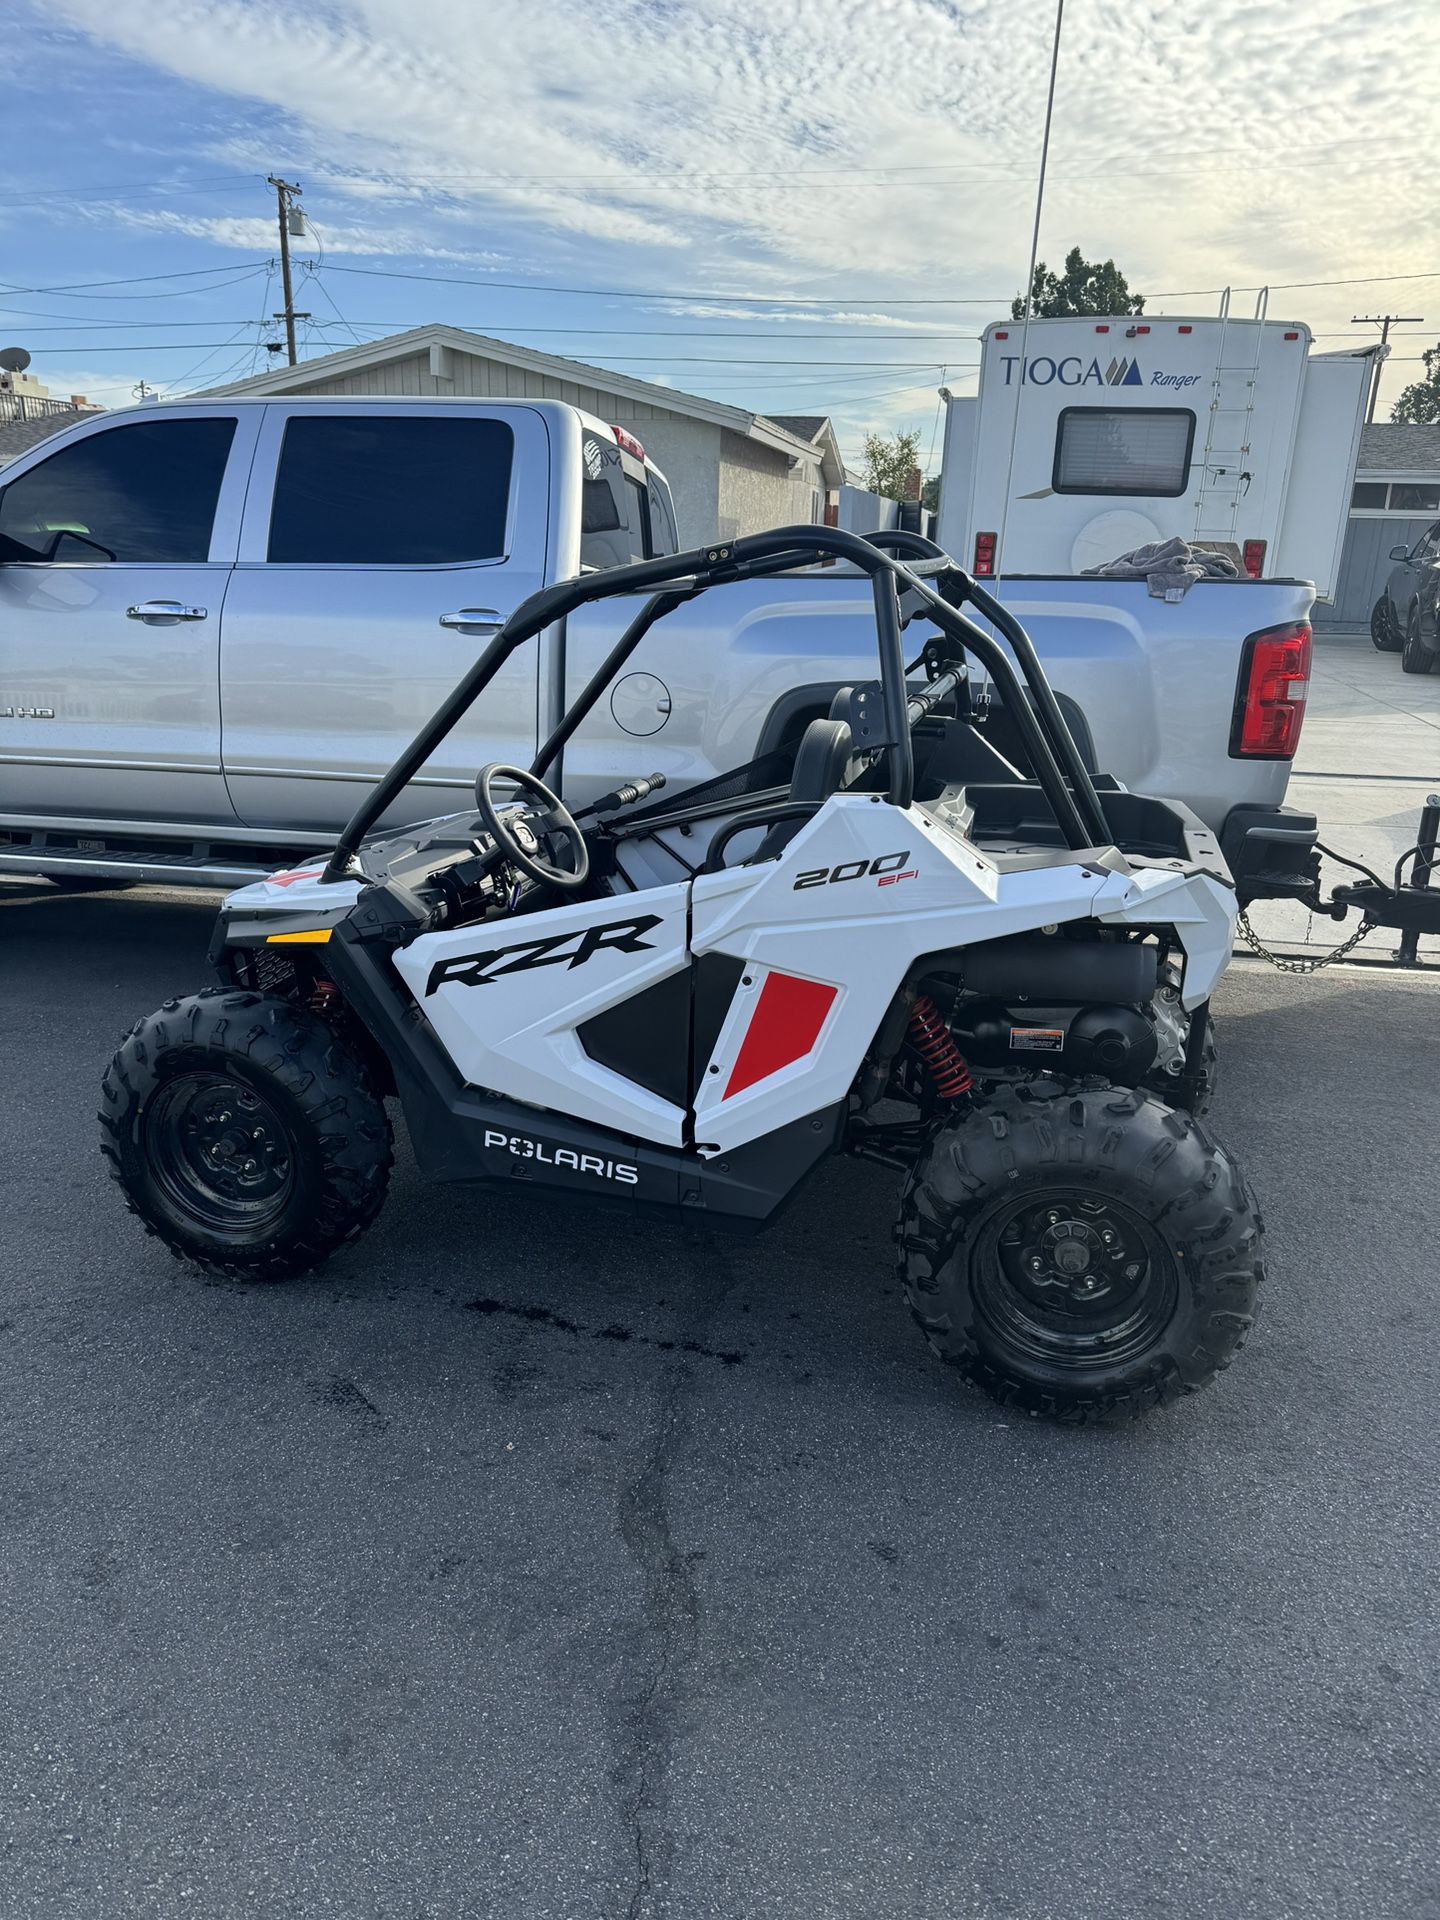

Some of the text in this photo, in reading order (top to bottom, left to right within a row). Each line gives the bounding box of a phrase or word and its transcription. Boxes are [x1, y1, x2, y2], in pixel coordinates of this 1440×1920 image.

[1000, 356, 1202, 391] TIOGA Ranger
[17, 706, 55, 719] HD
[793, 850, 911, 891] 200
[877, 869, 919, 887] EFI
[424, 913, 665, 998] RZR
[484, 1129, 639, 1185] POLARIS
